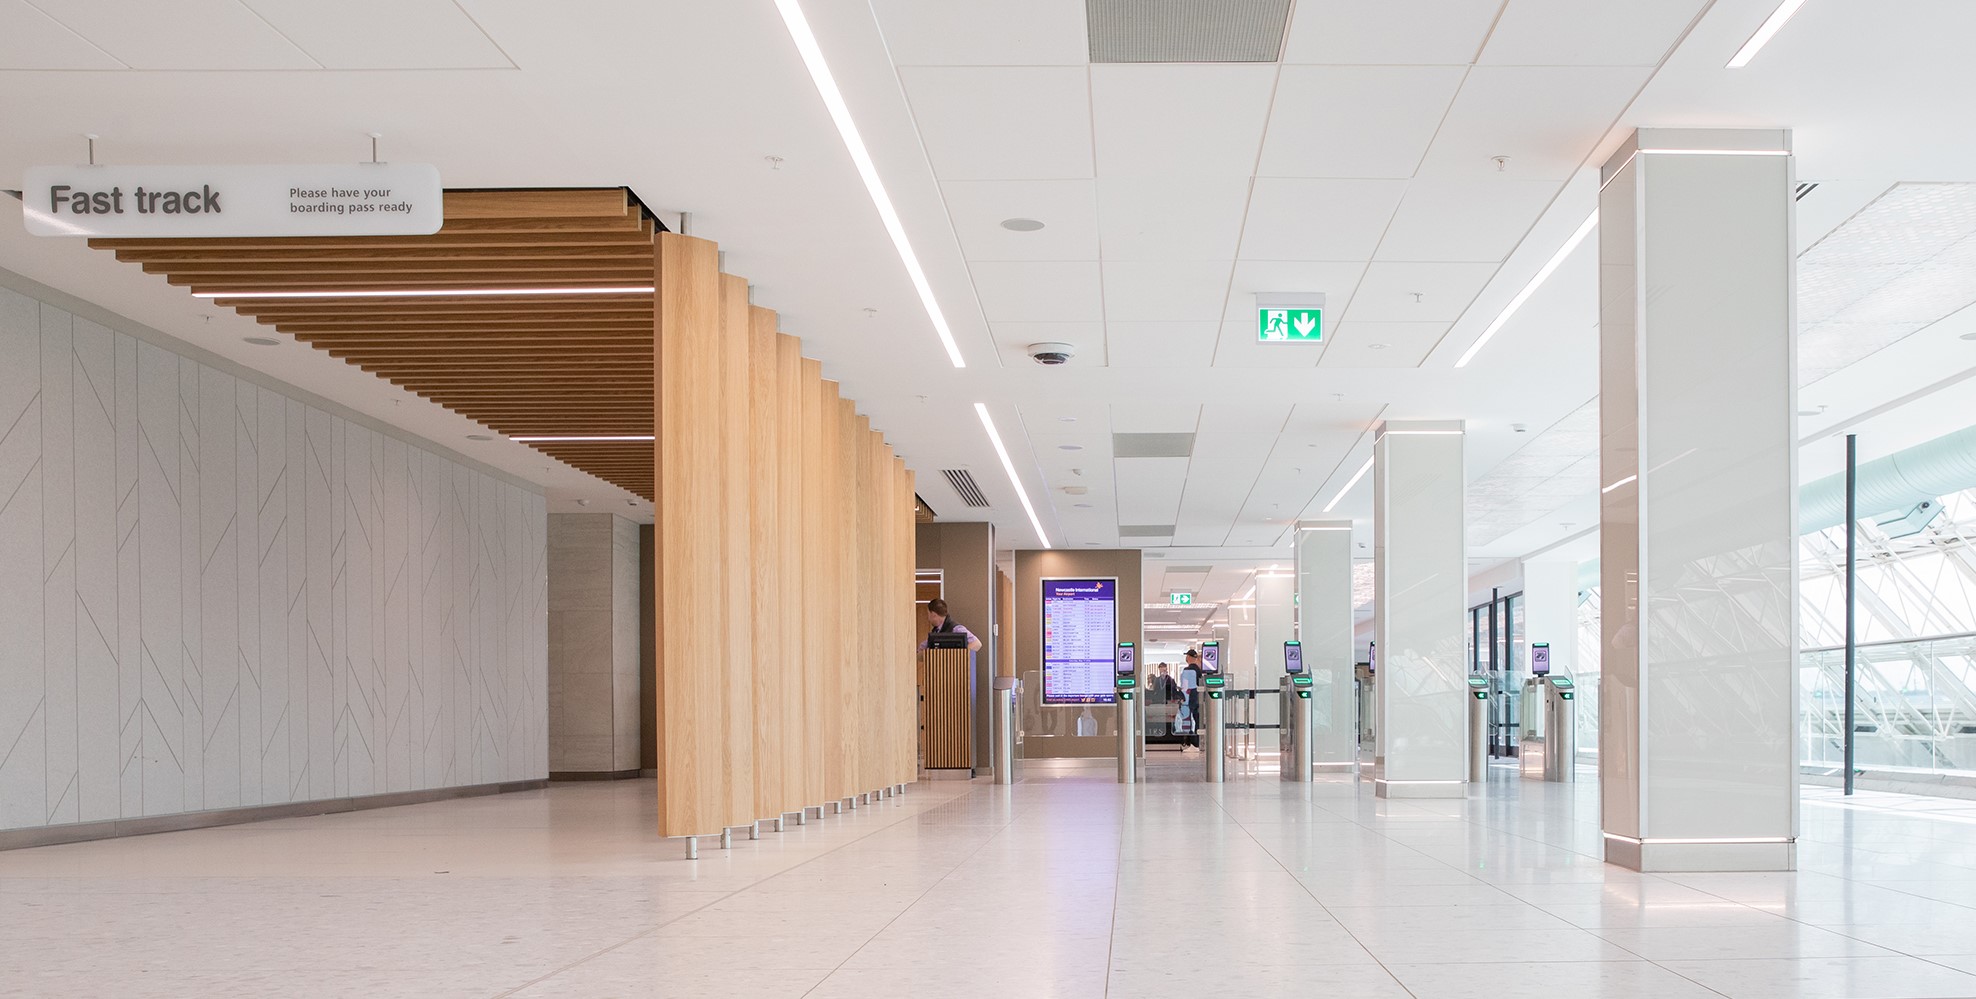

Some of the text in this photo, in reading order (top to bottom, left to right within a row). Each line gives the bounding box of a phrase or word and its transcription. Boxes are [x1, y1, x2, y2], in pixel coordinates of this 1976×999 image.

[51, 184, 222, 214] Fast track
[289, 187, 392, 200] Please have your
[290, 201, 413, 215] boarding pass ready
